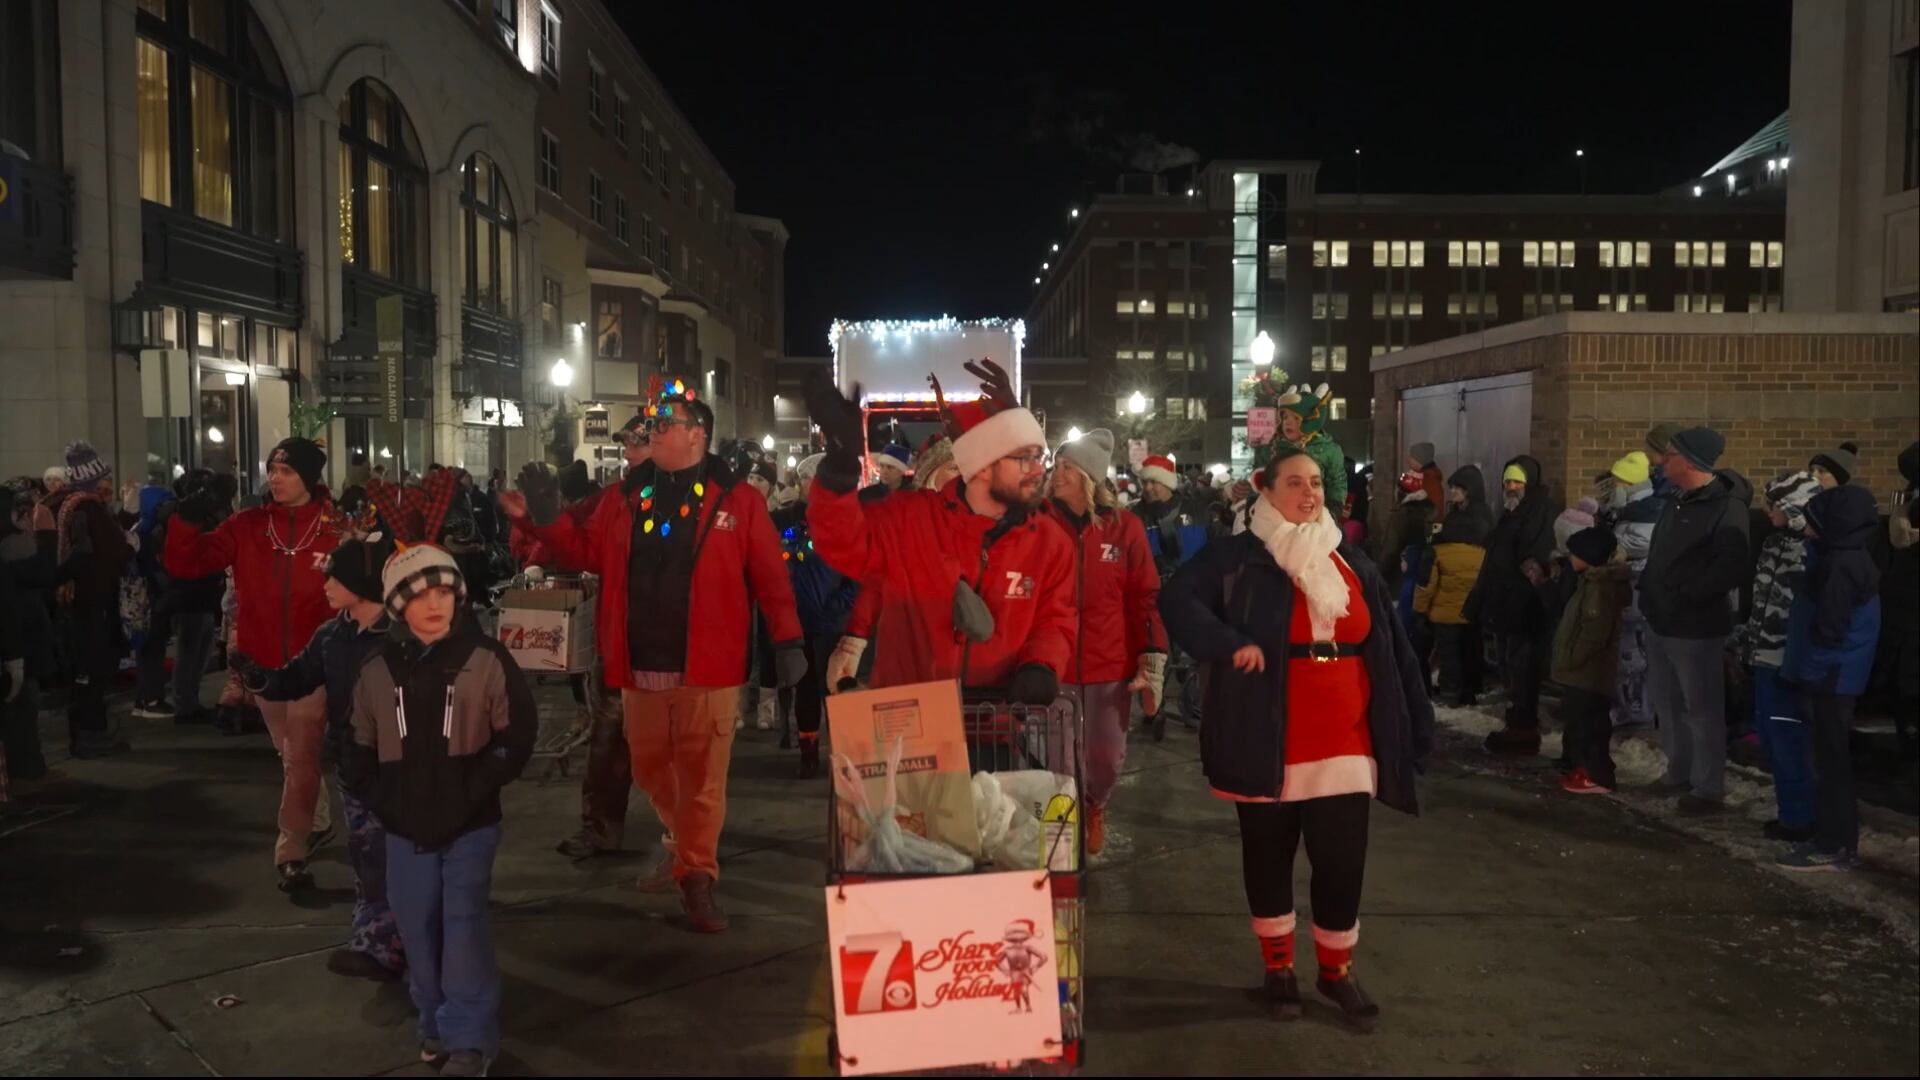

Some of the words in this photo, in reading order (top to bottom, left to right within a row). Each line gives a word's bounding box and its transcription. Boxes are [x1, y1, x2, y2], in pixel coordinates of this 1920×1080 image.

[387, 357, 398, 422] DOWNTOWN
[716, 510, 729, 527] 7
[1100, 543, 1113, 559] 7
[1006, 571, 1023, 595] 7
[893, 756, 932, 772] MALL
[915, 930, 1003, 972] Share
[845, 931, 903, 1012] 7
[953, 957, 1000, 980] your
[922, 974, 1024, 1008] Holiday
